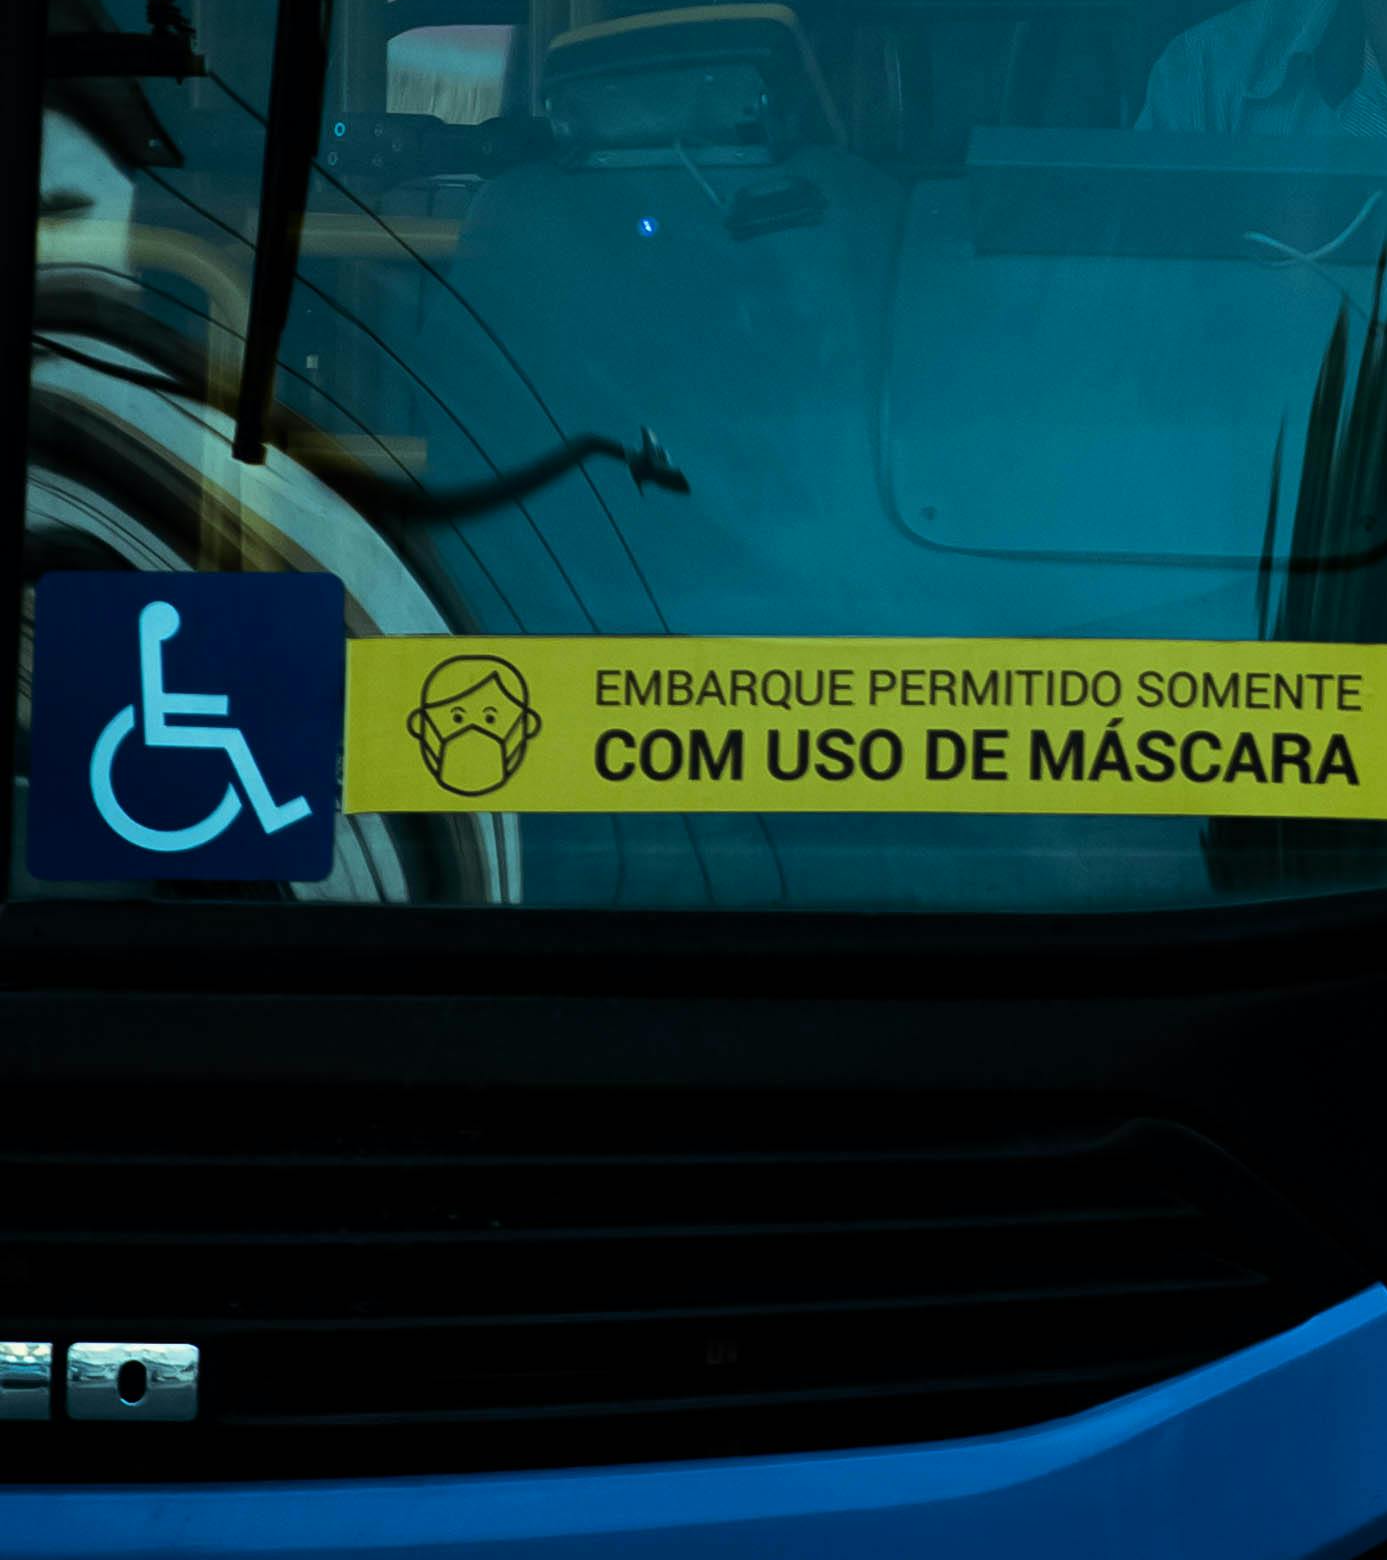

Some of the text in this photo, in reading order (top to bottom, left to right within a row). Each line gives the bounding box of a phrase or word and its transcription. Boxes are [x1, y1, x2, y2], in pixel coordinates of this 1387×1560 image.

[594, 668, 1363, 711] EMBARQUE PERMITIDO SOMENTE
[594, 717, 1360, 786] COM USO DE MÁSCARA
